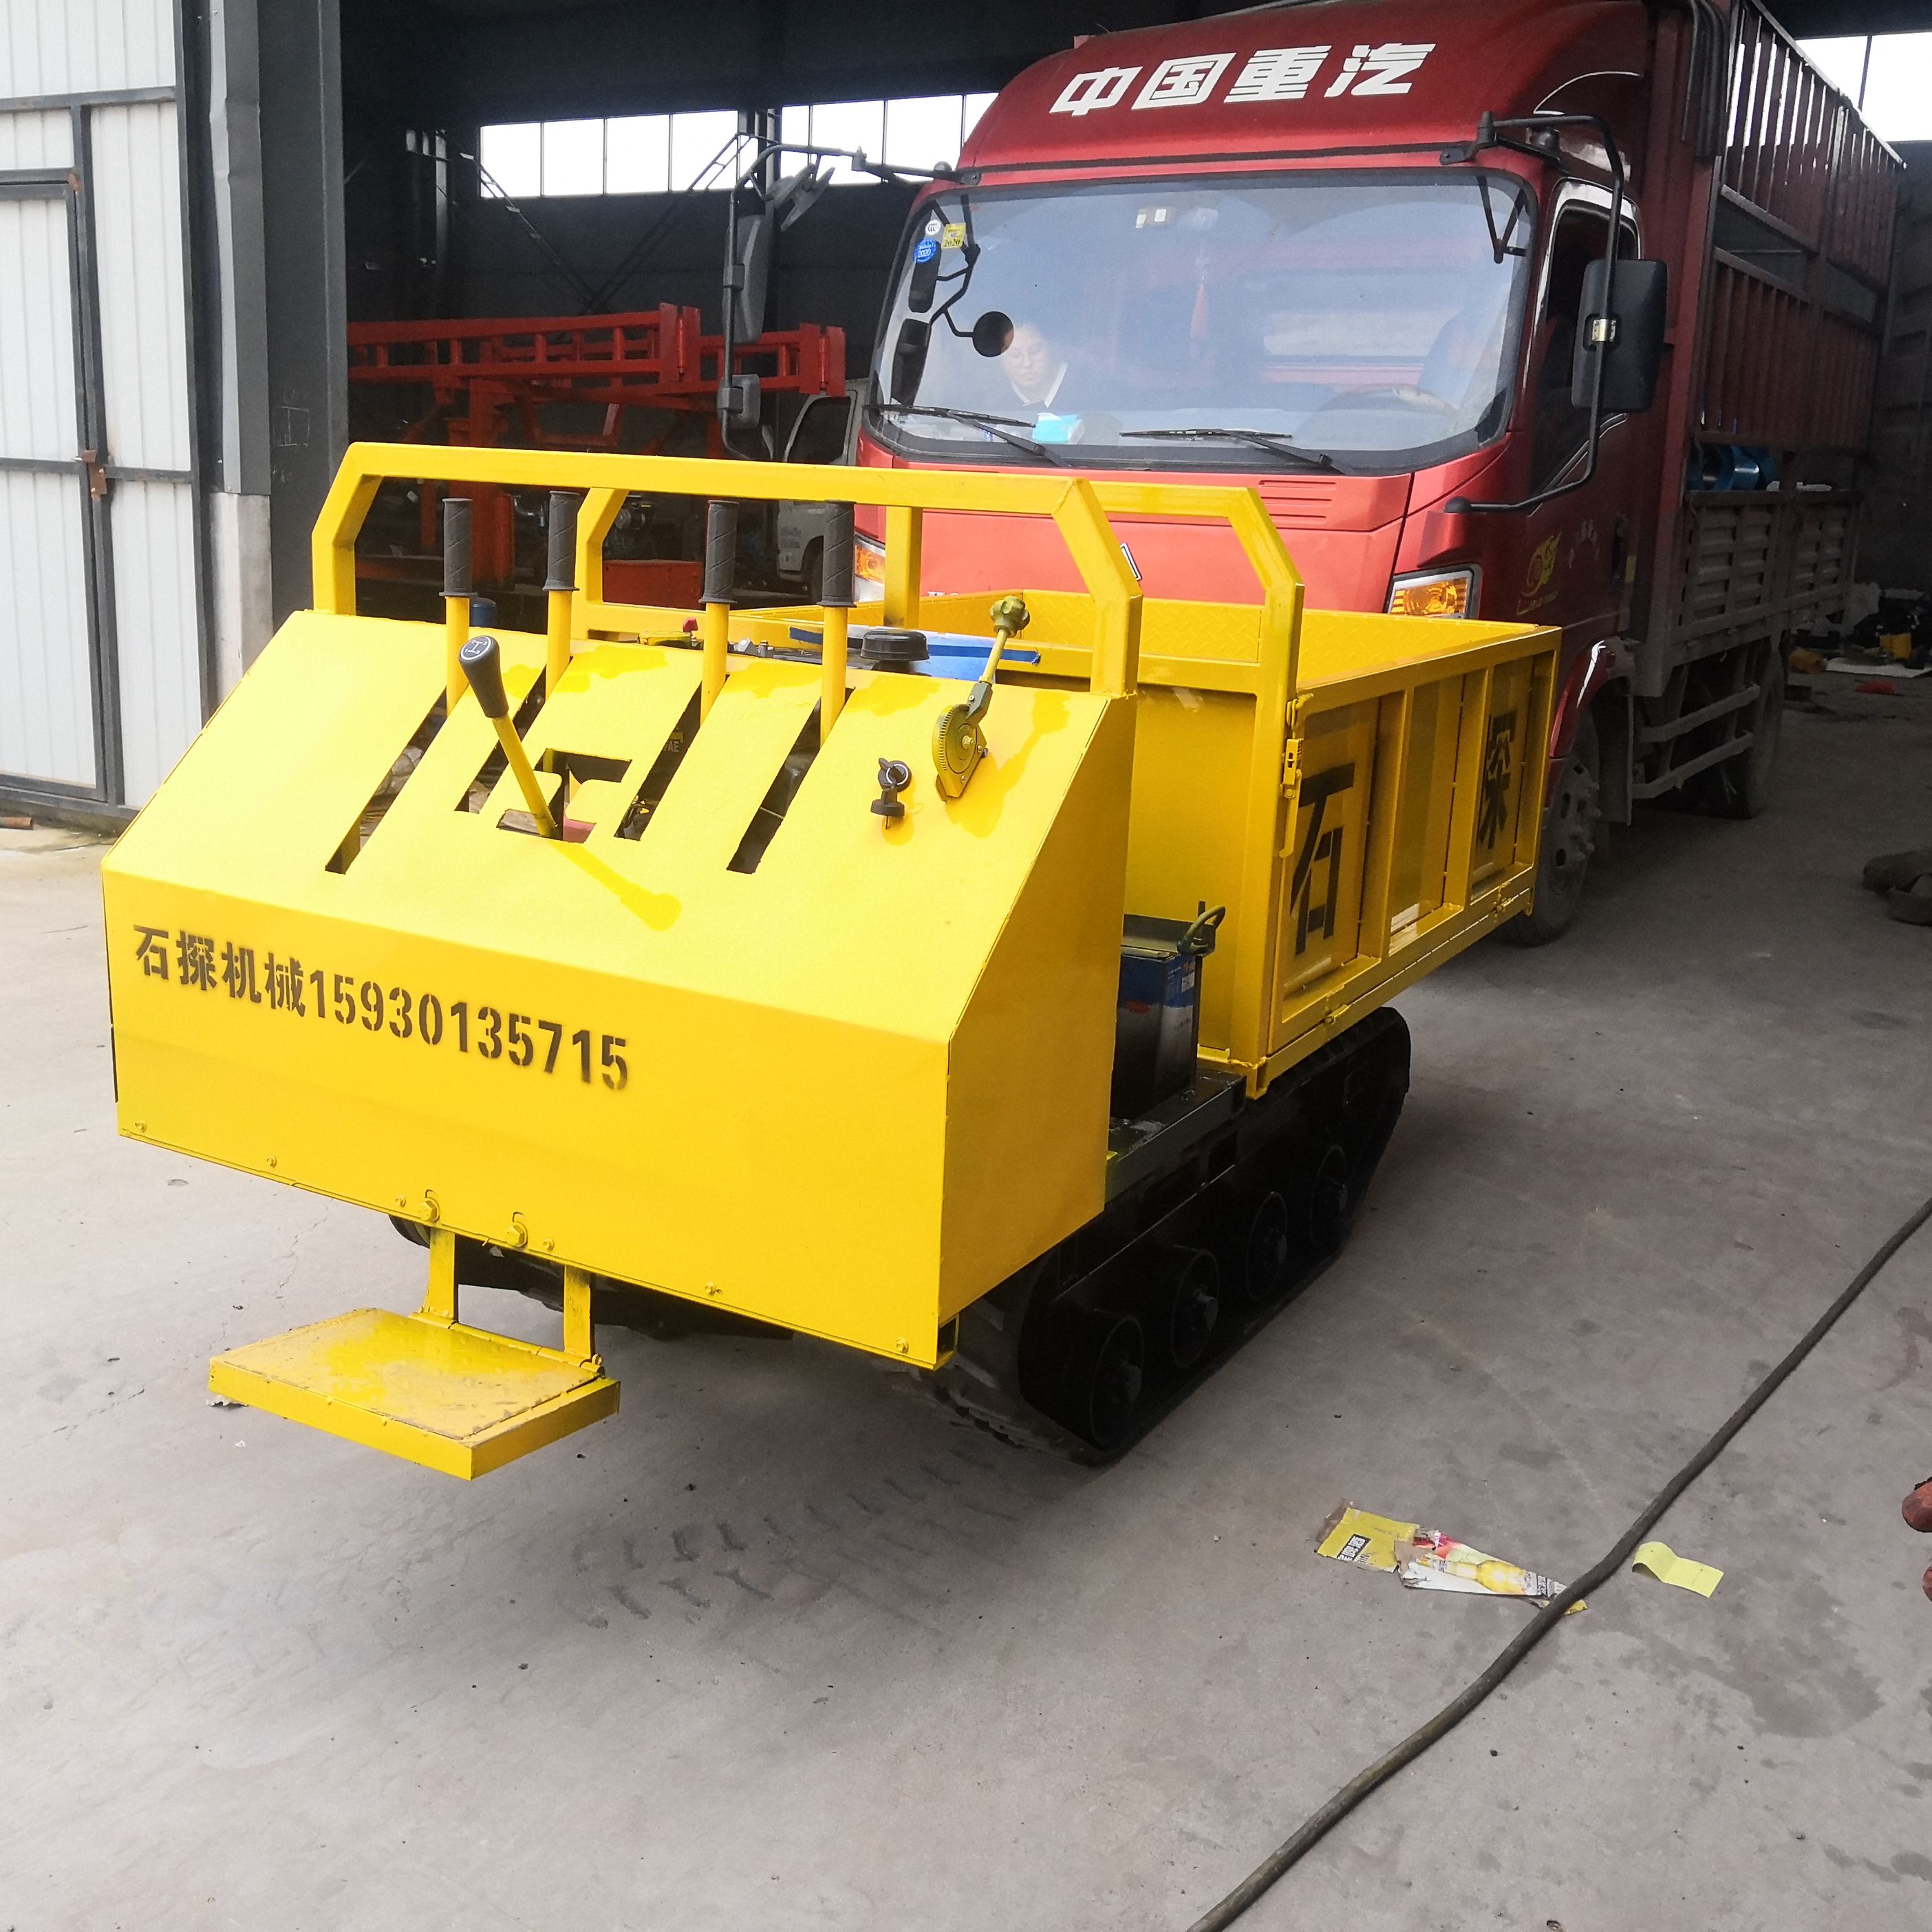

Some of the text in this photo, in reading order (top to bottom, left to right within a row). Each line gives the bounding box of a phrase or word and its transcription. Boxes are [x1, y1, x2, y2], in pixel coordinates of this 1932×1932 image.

[1049, 43, 1437, 116] 中国重汽
[917, 248, 932, 258] 2020
[1290, 762, 1355, 955] 石
[133, 923, 629, 1091] 石探机械15930135715
